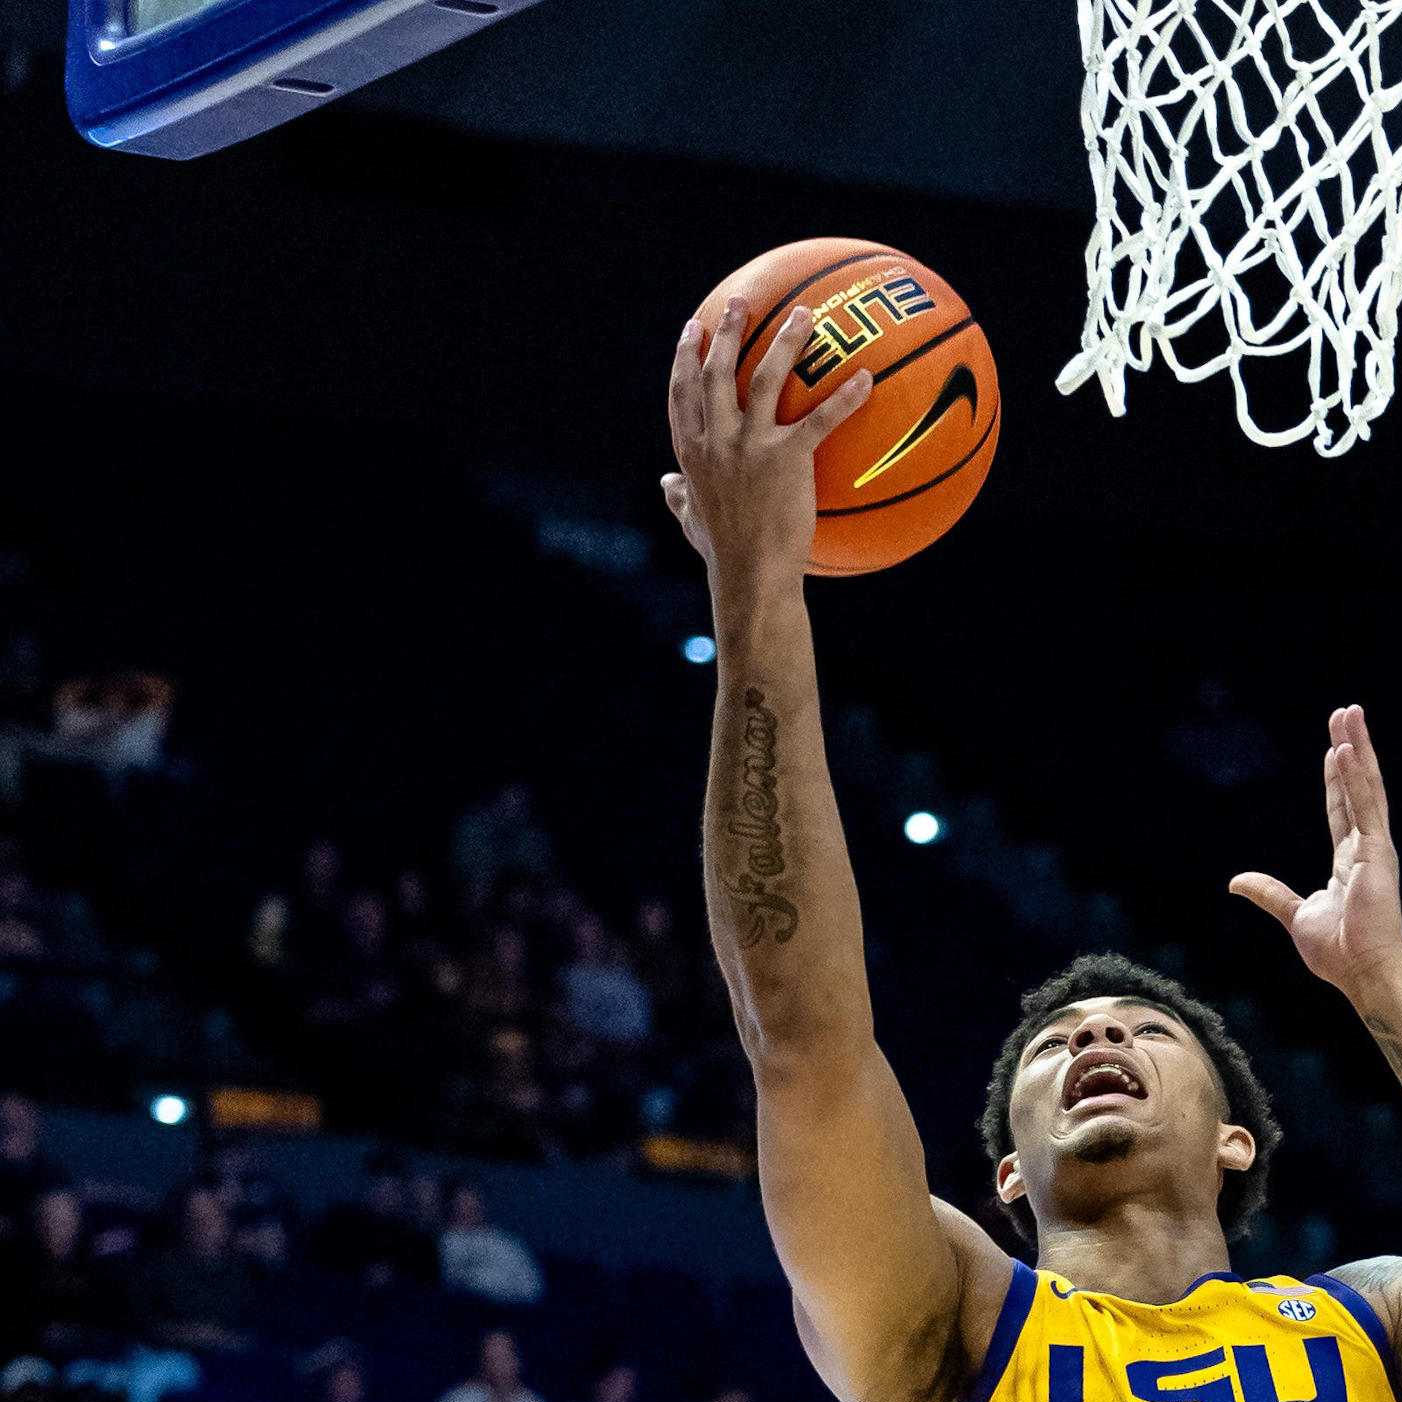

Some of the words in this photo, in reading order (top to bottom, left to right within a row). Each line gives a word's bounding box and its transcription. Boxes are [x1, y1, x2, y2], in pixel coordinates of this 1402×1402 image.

[811, 267, 907, 323] CHAMPION
[792, 276, 936, 389] ELITE
[1278, 1299, 1316, 1322] SEC
